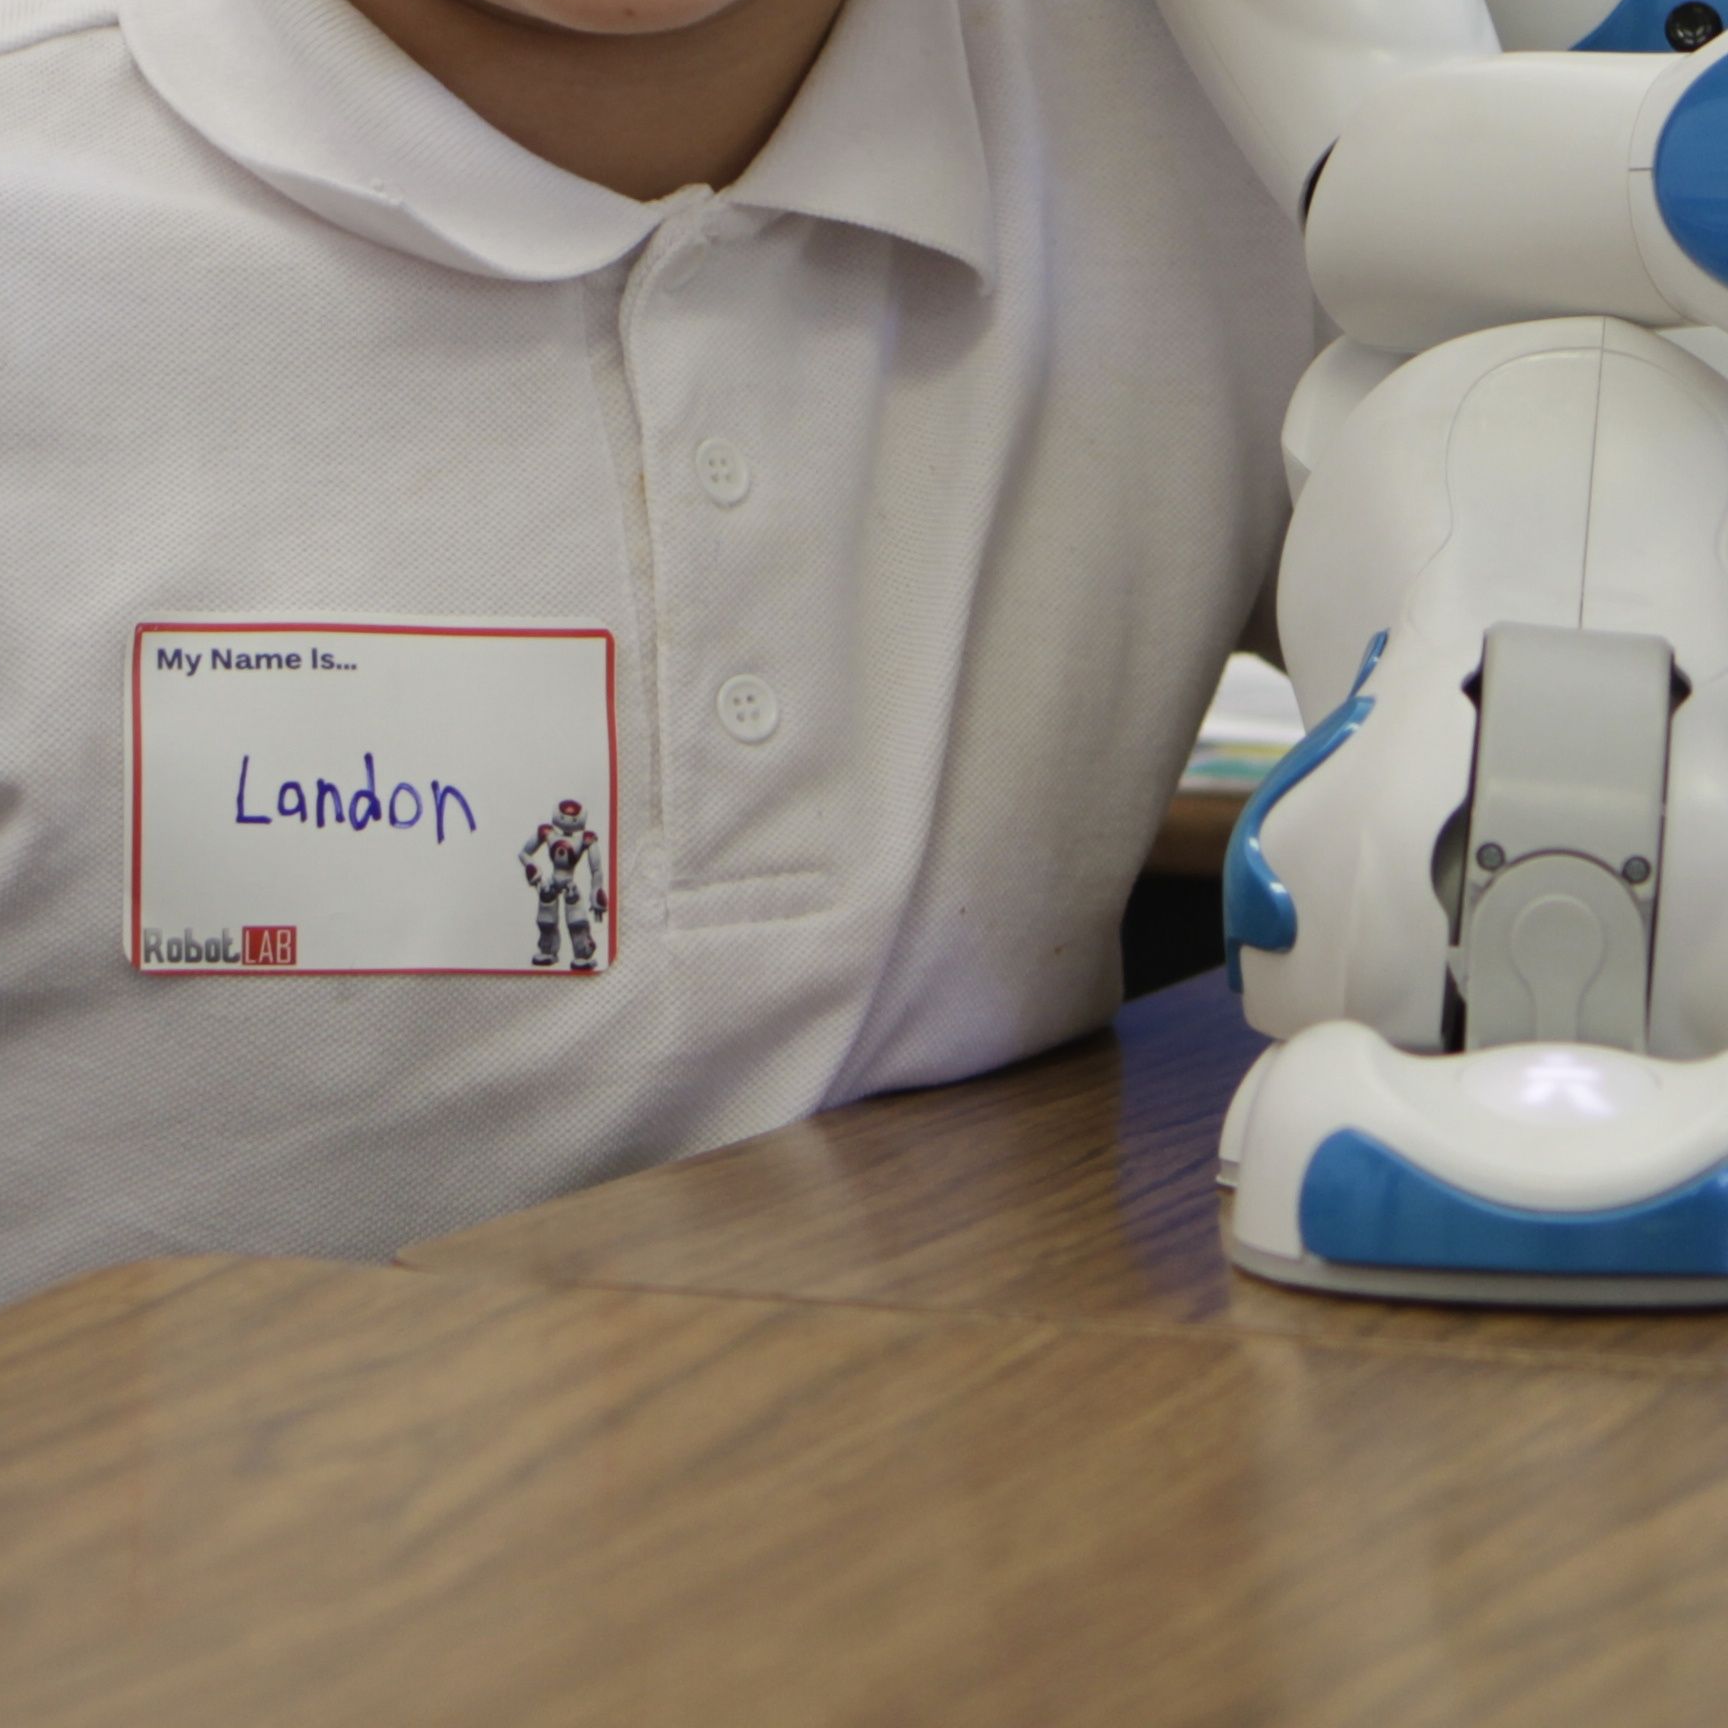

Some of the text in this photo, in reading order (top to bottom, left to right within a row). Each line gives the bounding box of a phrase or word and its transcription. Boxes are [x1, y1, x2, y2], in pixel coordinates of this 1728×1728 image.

[156, 647, 358, 676] My Name Is...
[235, 752, 476, 844] Landon
